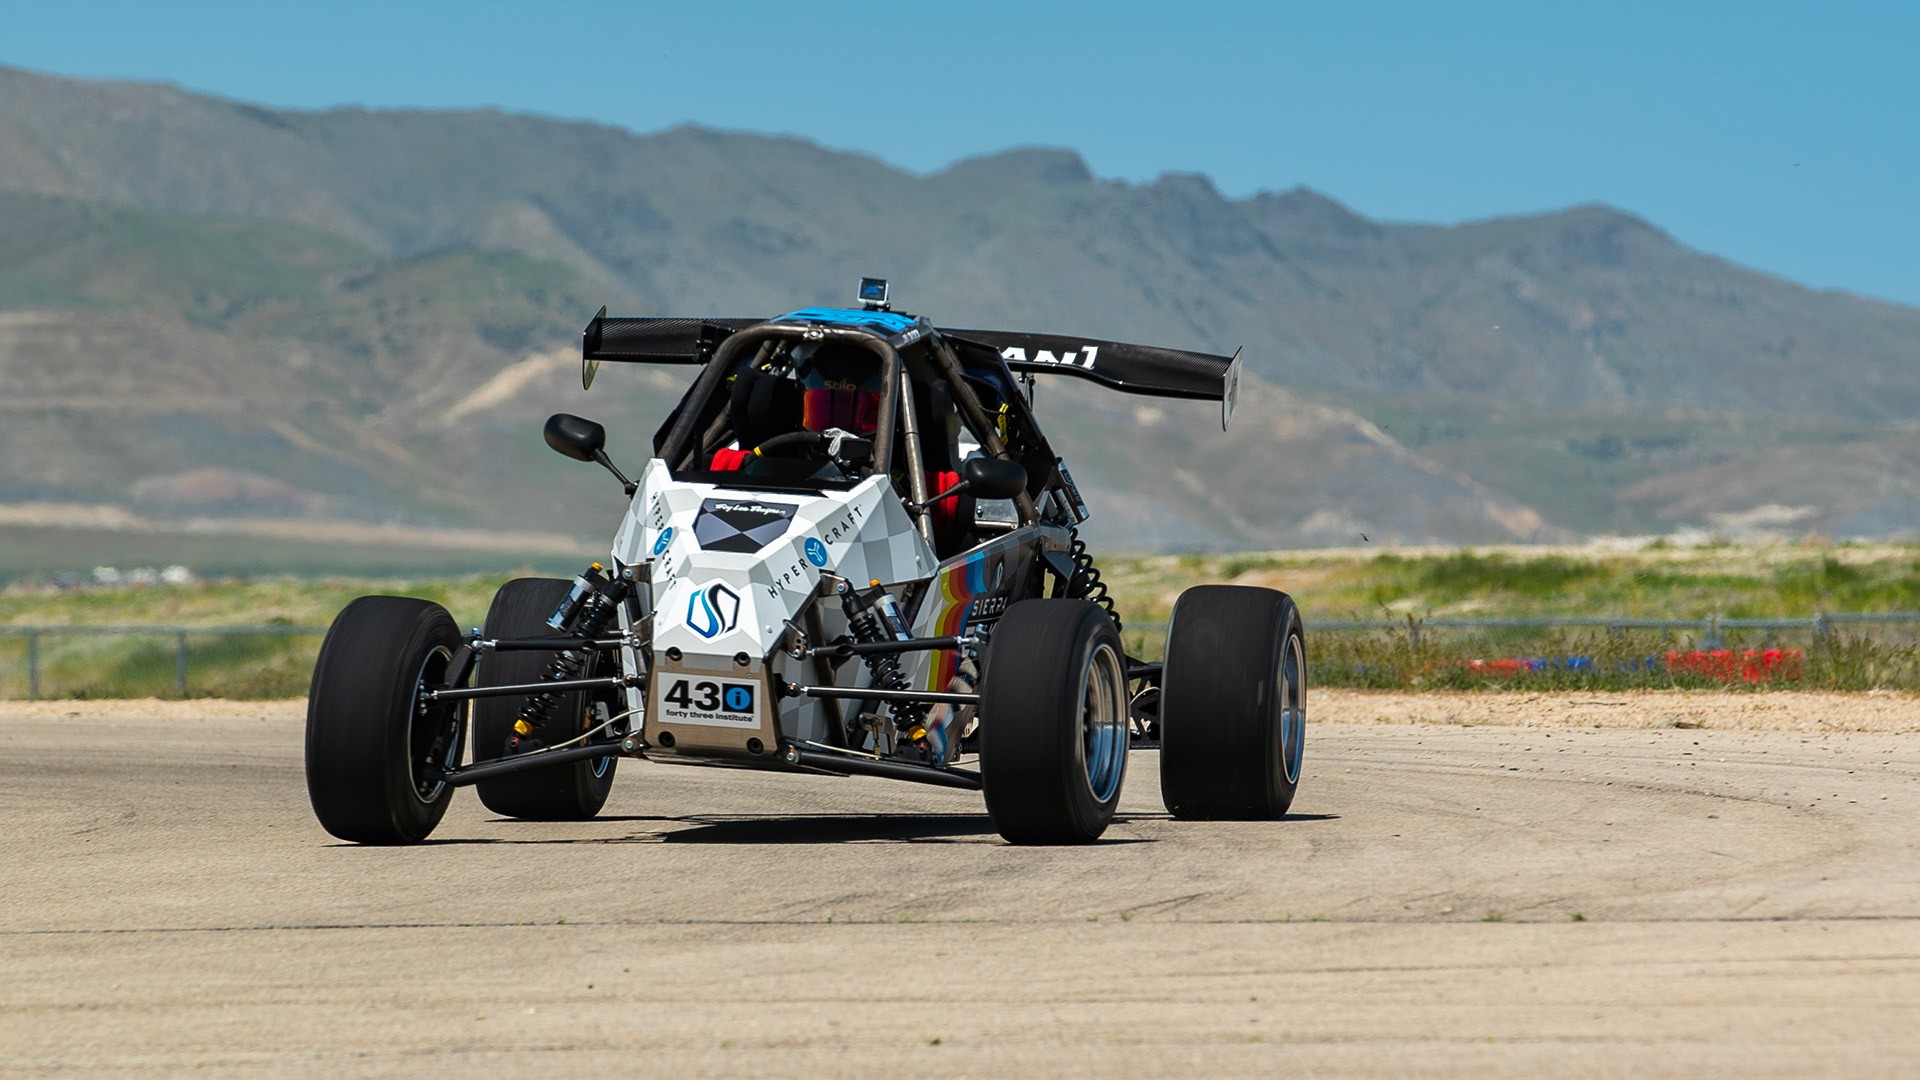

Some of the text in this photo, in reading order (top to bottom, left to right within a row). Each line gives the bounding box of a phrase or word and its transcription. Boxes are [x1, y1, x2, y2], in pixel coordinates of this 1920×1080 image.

[767, 506, 863, 599] HYPER CRAFT
[971, 597, 1008, 617] SIERRA
[665, 708, 688, 719] forty
[689, 711, 714, 720] three
